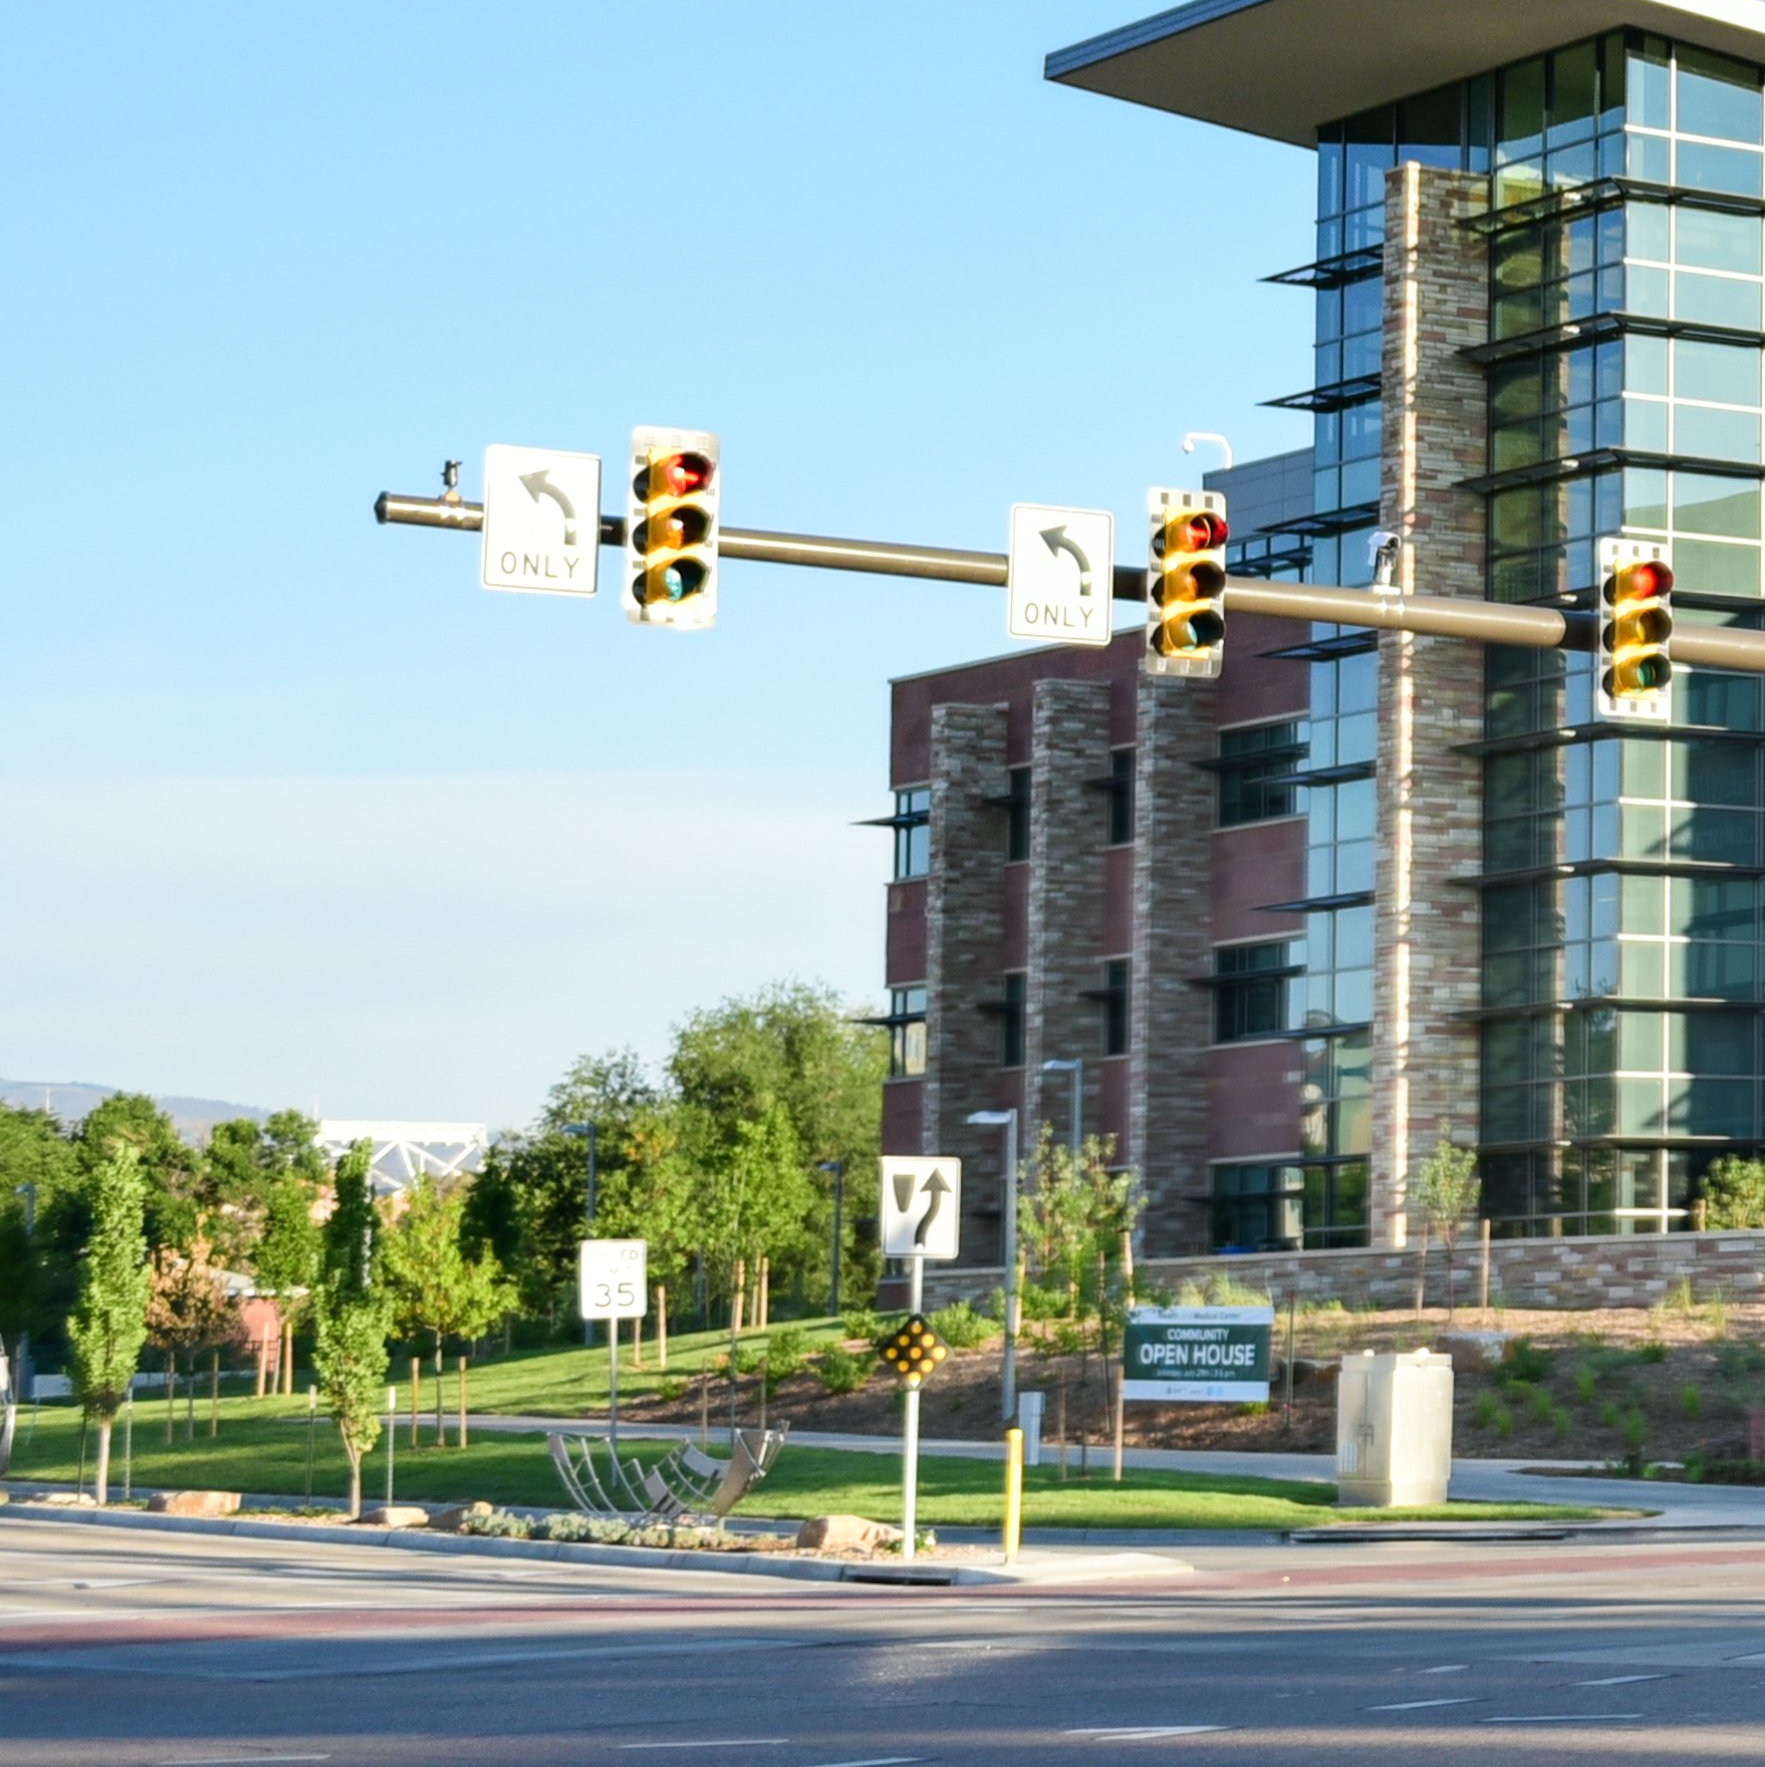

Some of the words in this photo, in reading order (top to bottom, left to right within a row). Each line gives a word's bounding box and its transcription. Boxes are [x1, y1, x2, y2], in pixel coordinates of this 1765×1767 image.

[500, 550, 580, 580] ONLY
[1024, 601, 1095, 628] ONLY
[594, 1282, 636, 1308] 35
[1166, 1328, 1231, 1342] COMMUNITY
[1139, 1343, 1190, 1366] OPEN
[1192, 1343, 1257, 1367] HOUSE
